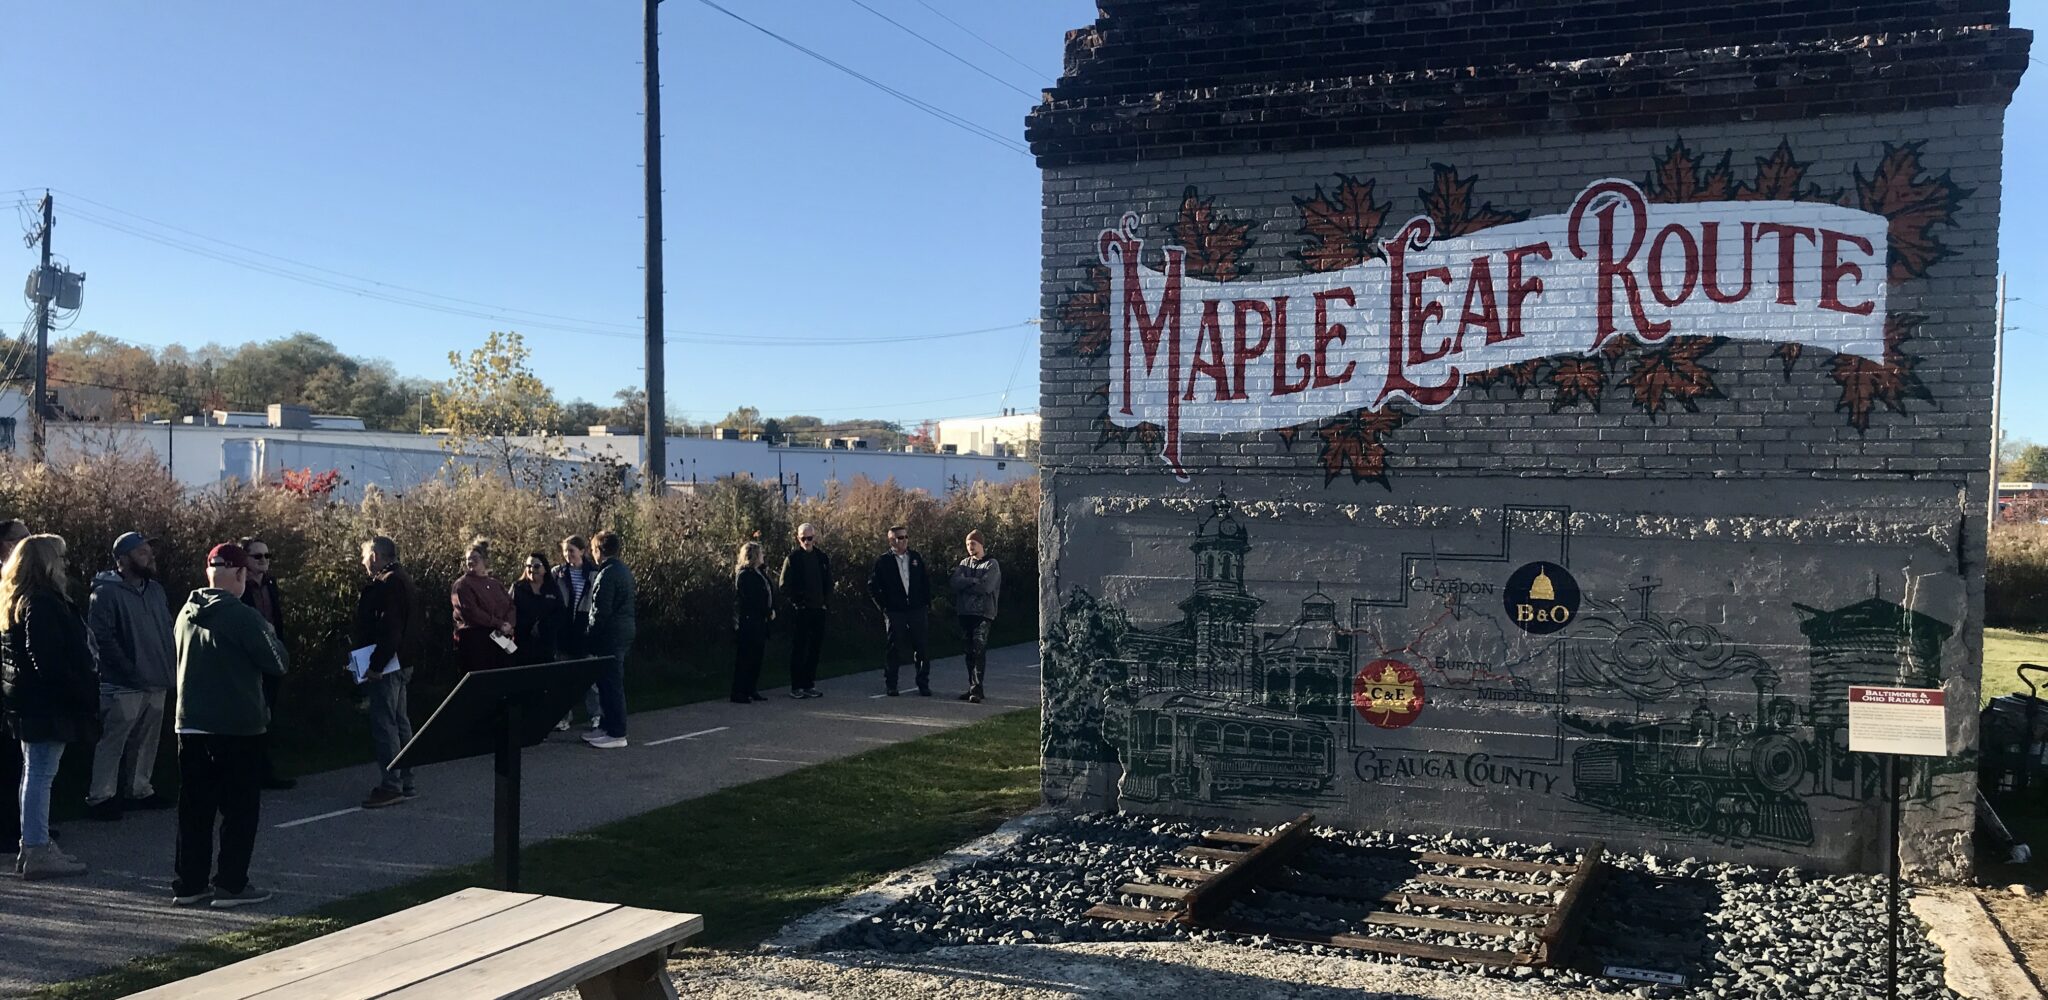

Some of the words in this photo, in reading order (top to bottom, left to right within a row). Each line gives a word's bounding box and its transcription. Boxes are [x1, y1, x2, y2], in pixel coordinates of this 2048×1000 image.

[1099, 210, 1357, 479] MAPLE
[1371, 217, 1551, 409] LEAF
[1569, 180, 1876, 354] ROUTE
[1409, 577, 1493, 595] CHARDON
[1435, 656, 1492, 673] BURTON
[1477, 686, 1570, 705] MIDDLEFIELD
[1865, 690, 1918, 698] BALTIMORE
[1888, 696, 1931, 704] RAILWAY
[1354, 751, 1458, 783] GEAUGA
[1464, 753, 1560, 794] COUNTY
